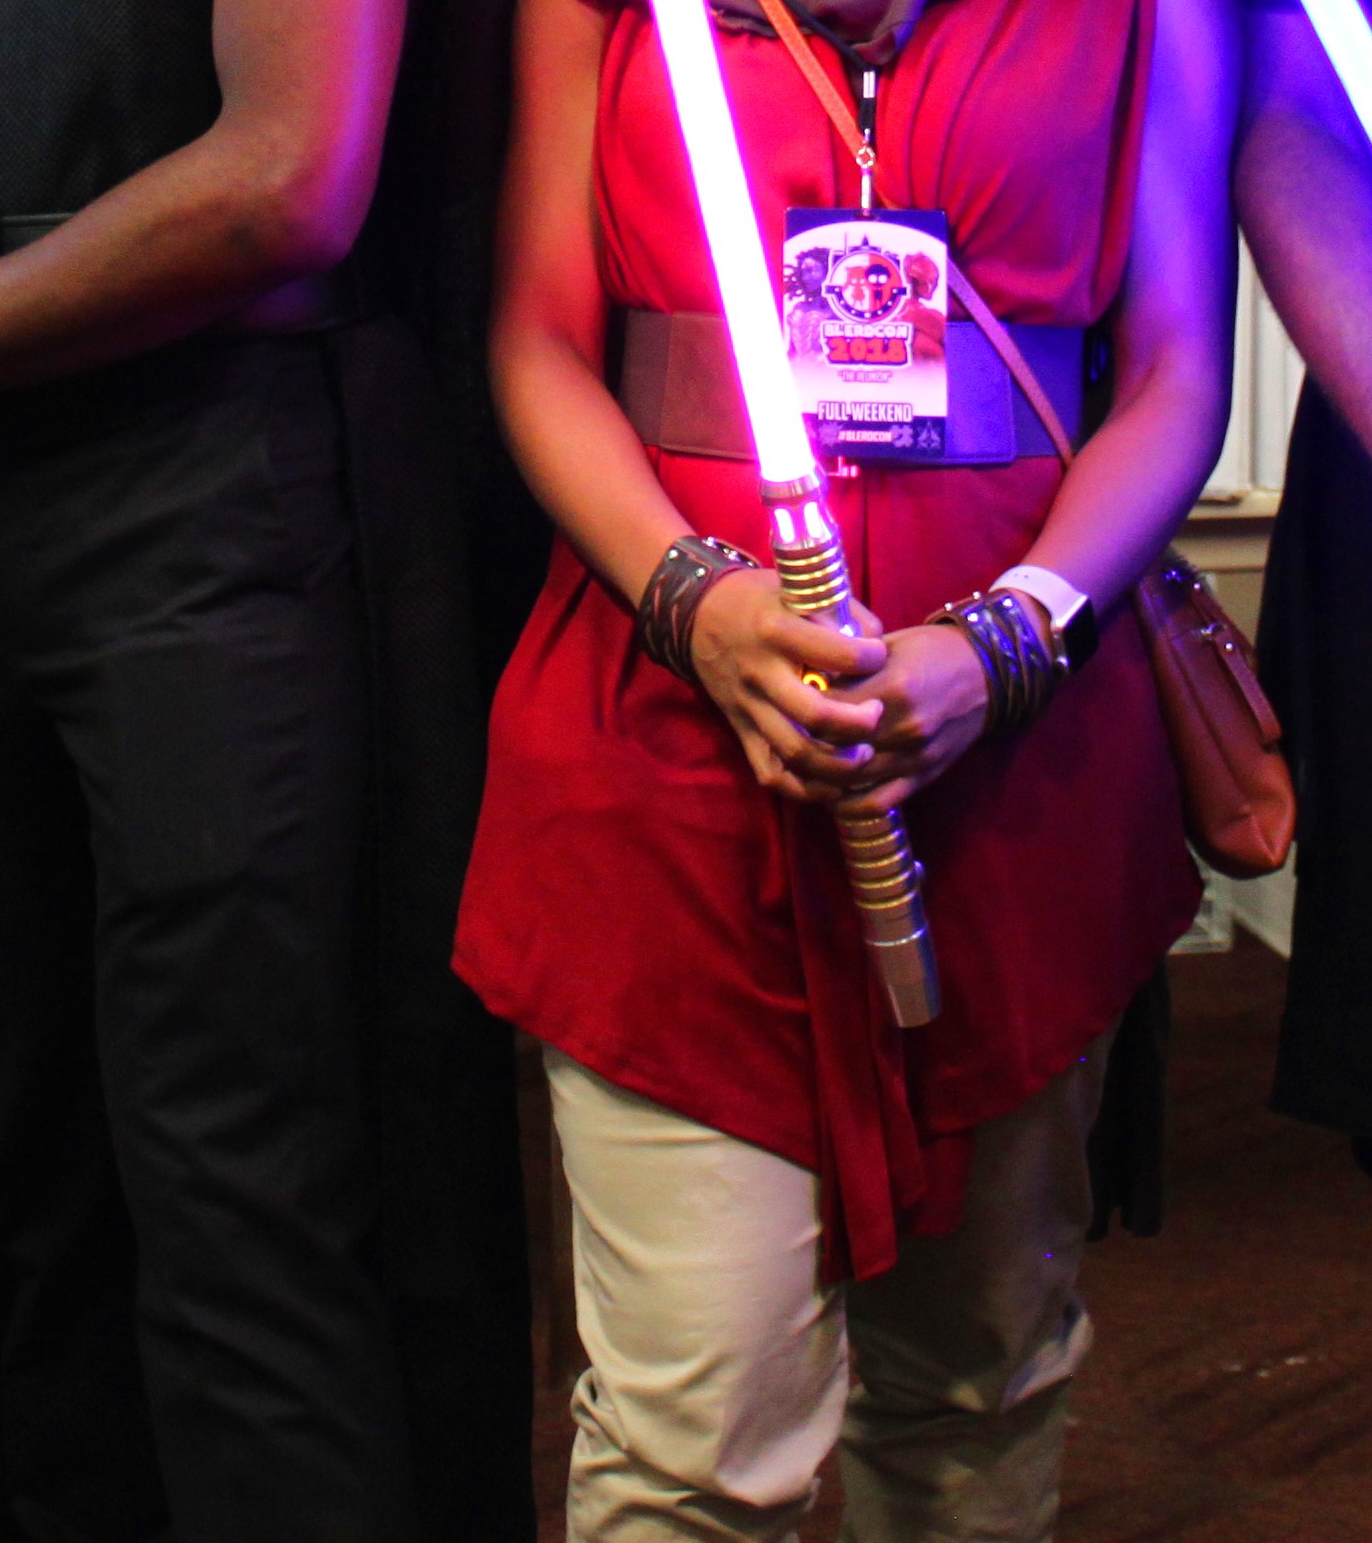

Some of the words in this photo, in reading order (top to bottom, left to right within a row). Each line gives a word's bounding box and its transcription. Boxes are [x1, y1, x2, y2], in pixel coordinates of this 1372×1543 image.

[828, 337, 907, 363] 2018
[818, 401, 849, 421] FULL
[850, 402, 913, 423] WEEKEND
